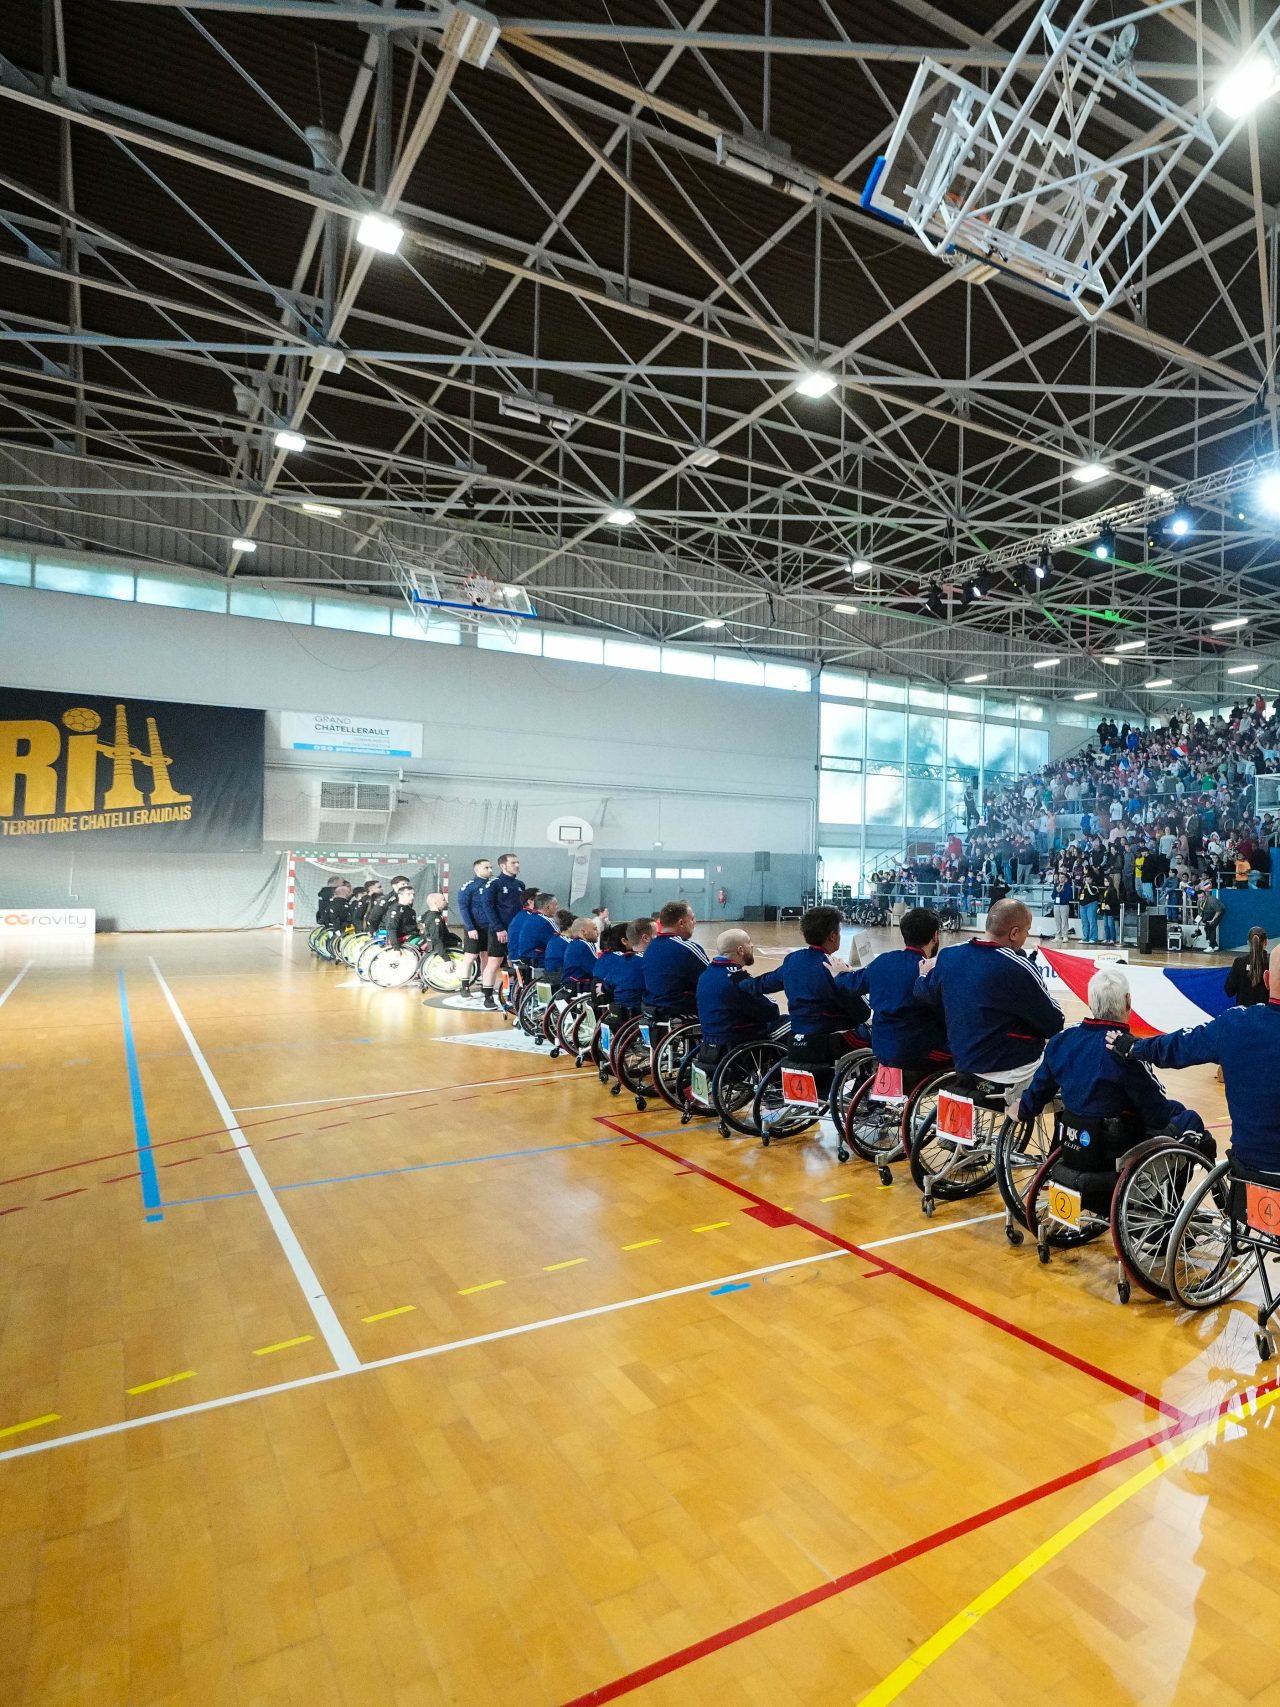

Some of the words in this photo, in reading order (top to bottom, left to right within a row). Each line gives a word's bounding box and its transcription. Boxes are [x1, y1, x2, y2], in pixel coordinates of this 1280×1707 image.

[314, 716, 352, 725] GRAND
[2, 815, 77, 836] TERRITOIRE
[79, 805, 192, 831] CHATELLERAUDAIS
[796, 1080, 803, 1093] 4
[879, 1071, 886, 1087] 4
[1060, 1197, 1066, 1213] 2
[1264, 1203, 1273, 1219] 4
